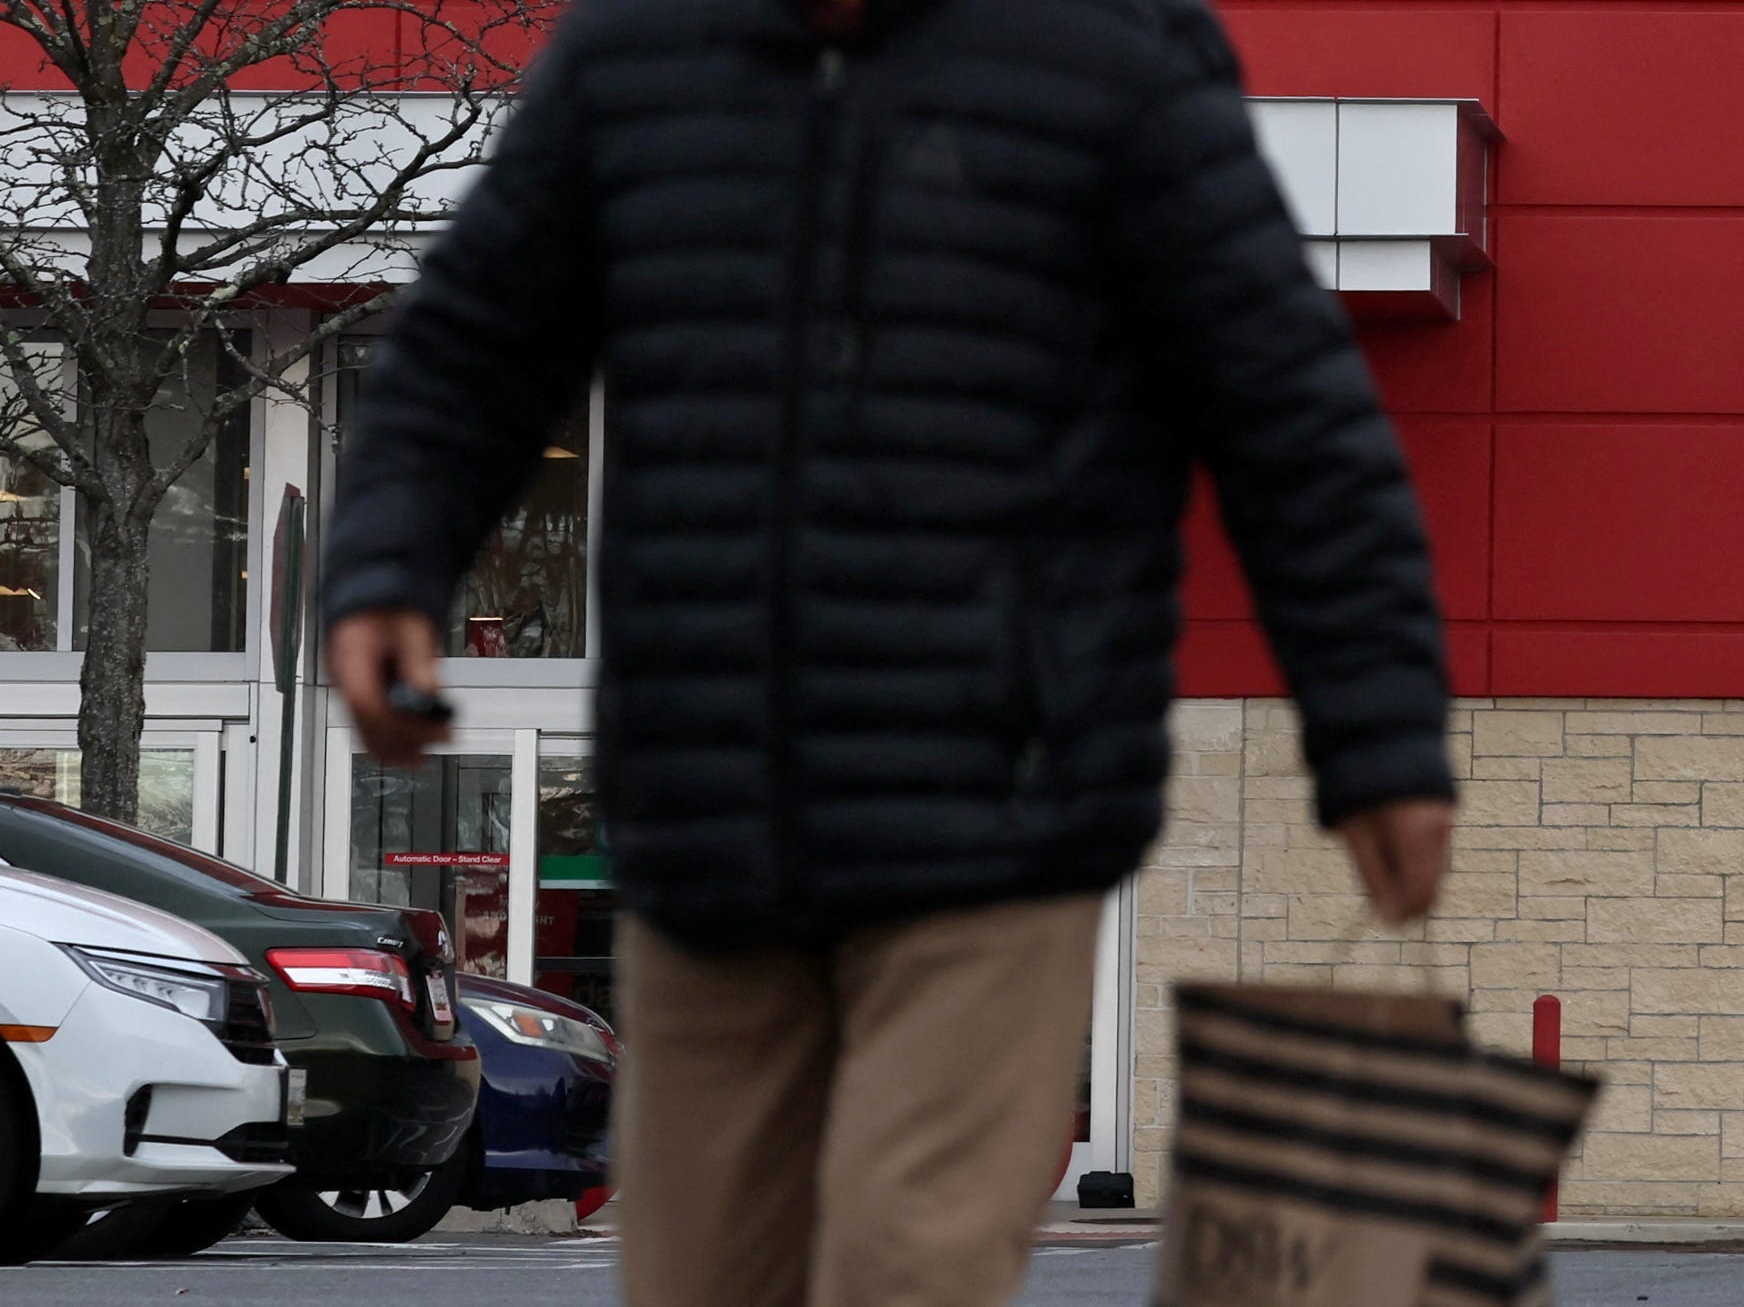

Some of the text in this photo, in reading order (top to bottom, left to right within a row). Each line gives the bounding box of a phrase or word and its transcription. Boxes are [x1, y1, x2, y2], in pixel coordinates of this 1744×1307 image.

[393, 855, 431, 863] Automatic
[433, 855, 451, 863] Door
[458, 855, 480, 863] Stand
[481, 855, 501, 863] Clear
